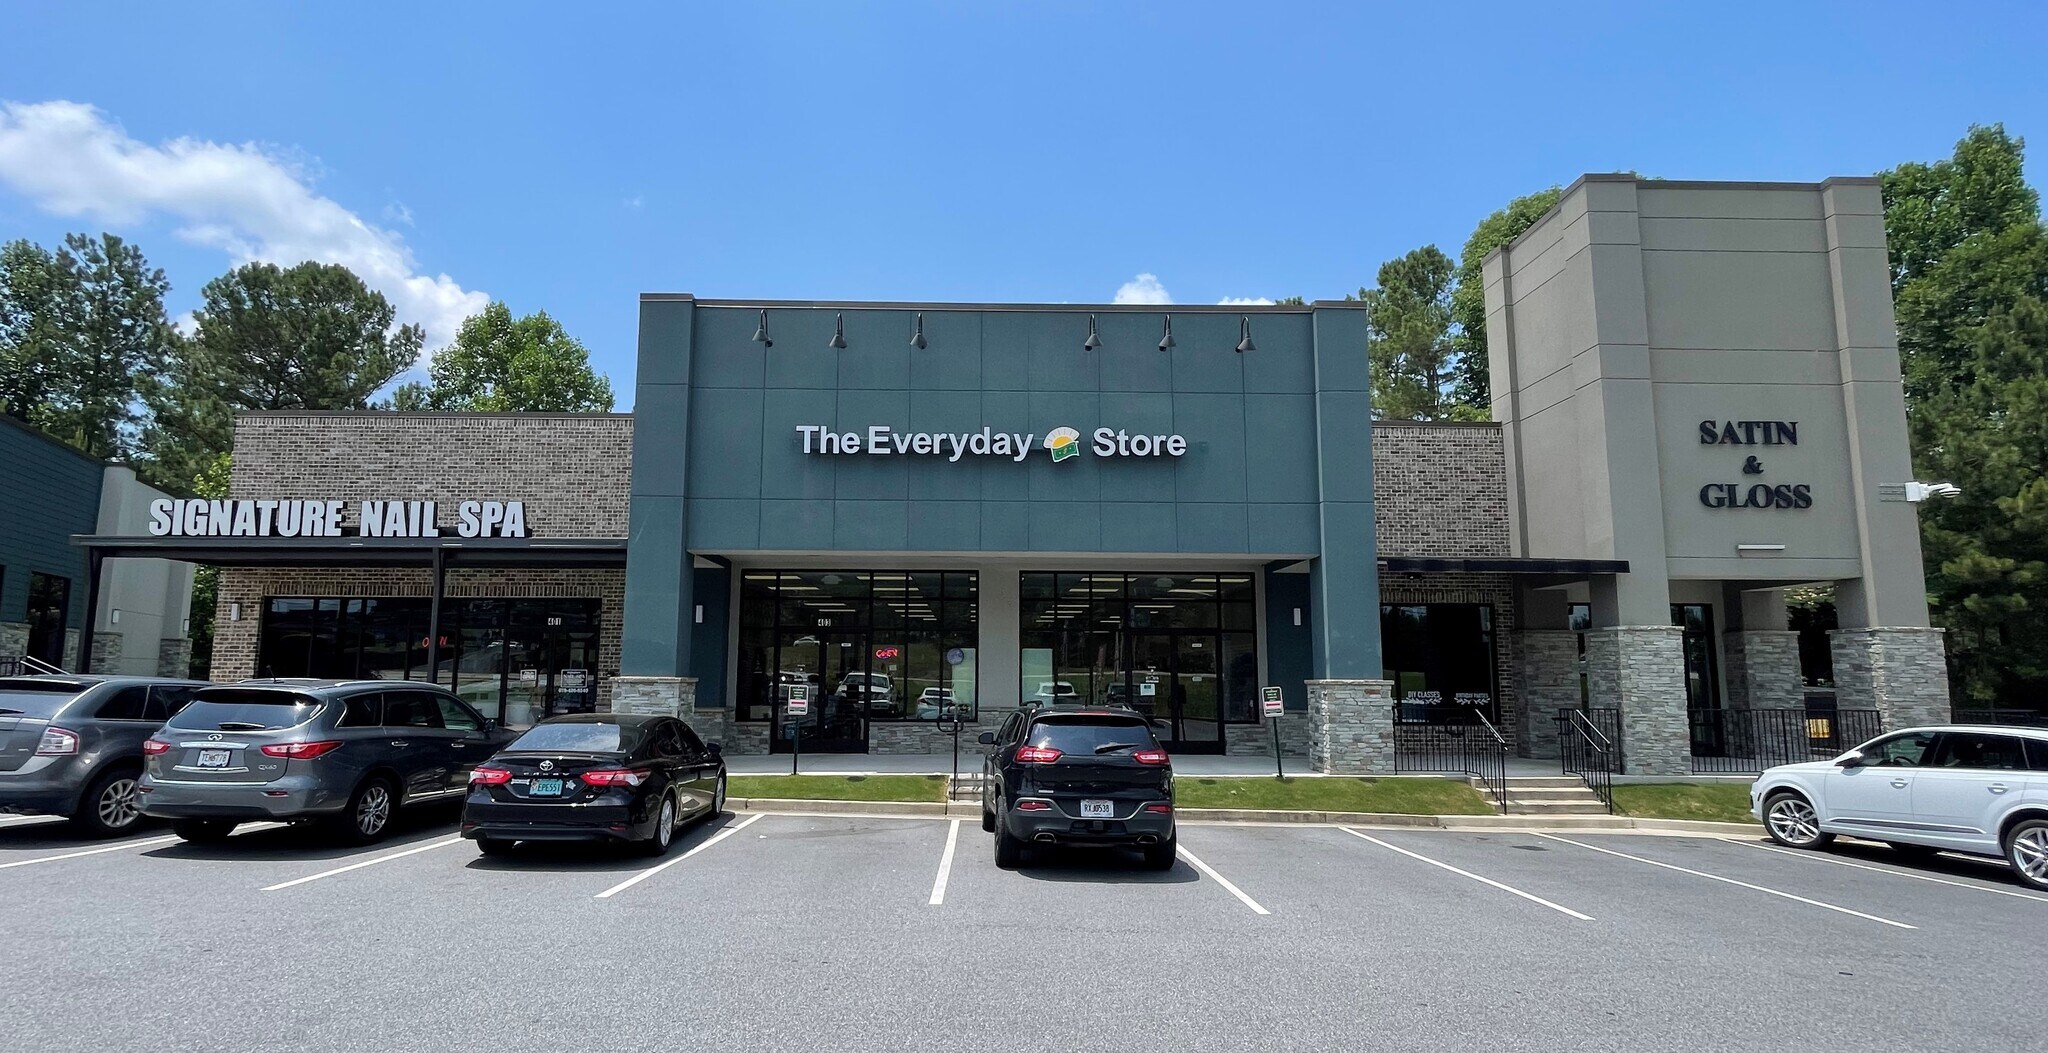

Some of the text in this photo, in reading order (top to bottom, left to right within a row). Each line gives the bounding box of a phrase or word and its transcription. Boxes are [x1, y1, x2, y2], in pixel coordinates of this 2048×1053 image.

[795, 425, 1187, 462] The Everyday Store
[1699, 420, 1799, 446] SATIN
[1742, 455, 1764, 475] &
[1700, 483, 1813, 509] GLOSS
[149, 499, 526, 539] SIGNATURE NAIL SPA
[547, 617, 562, 626] 401
[422, 635, 448, 648] ON
